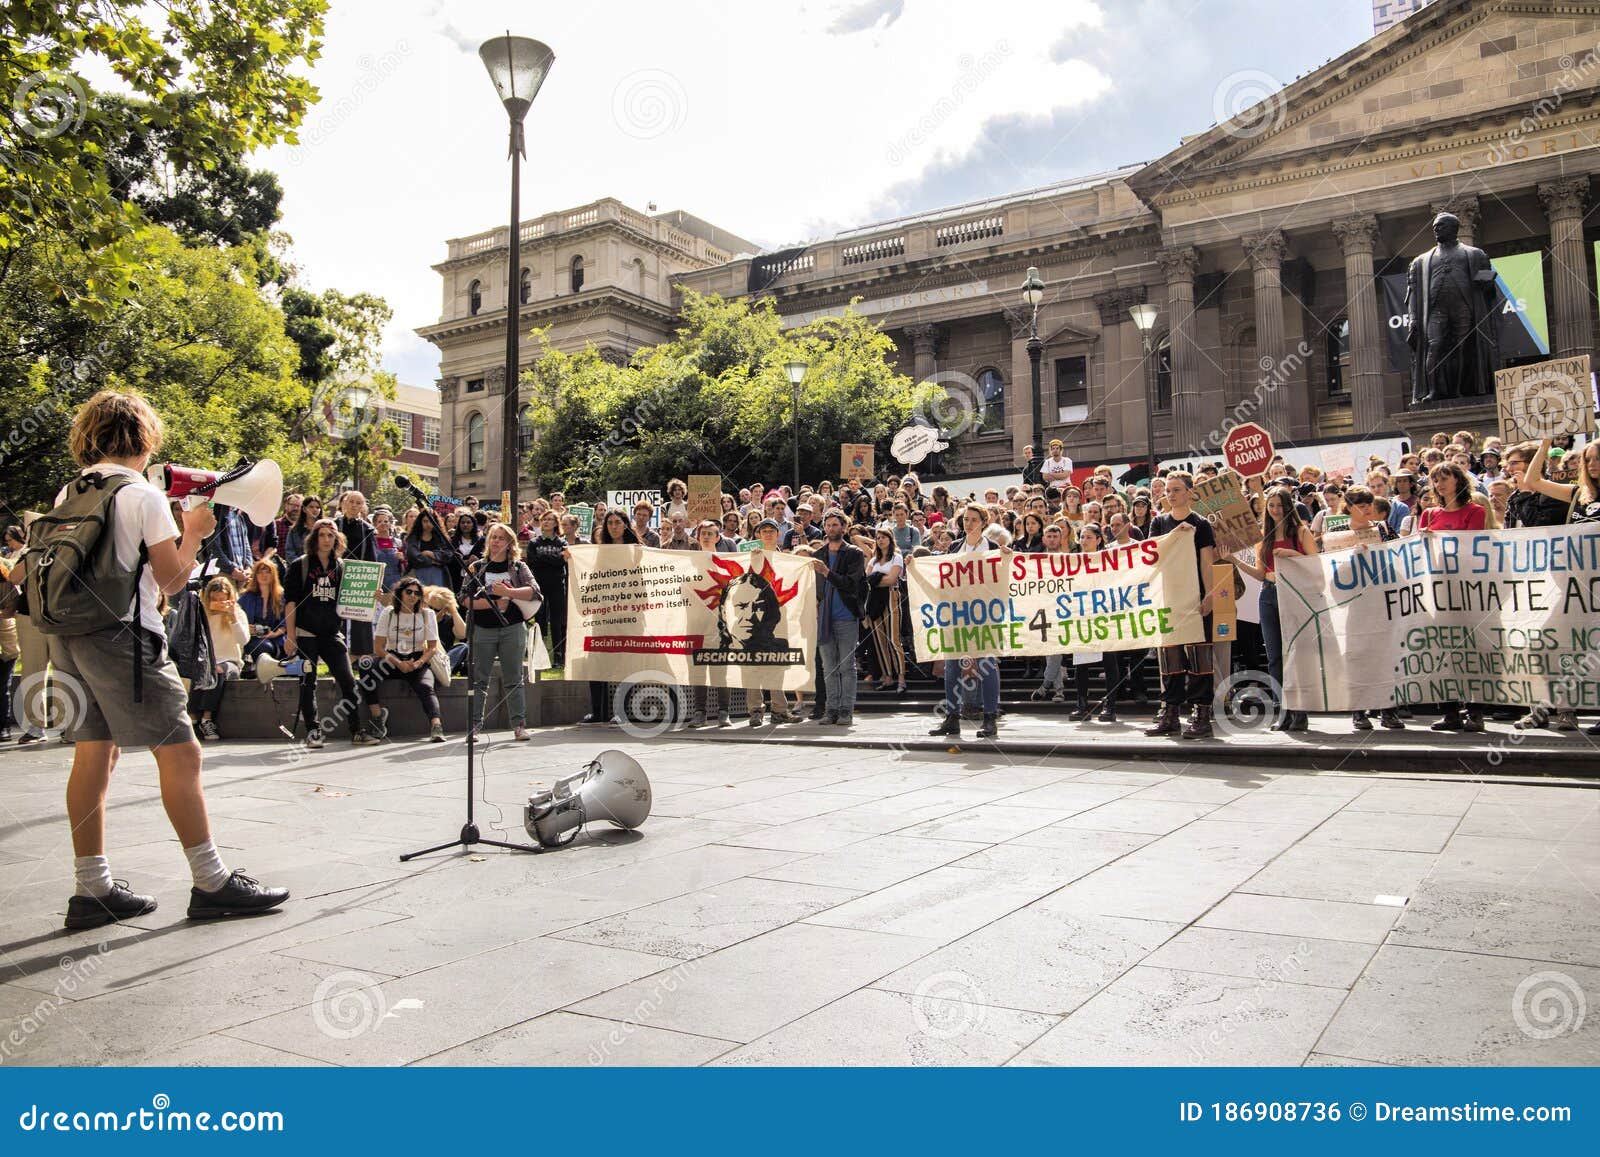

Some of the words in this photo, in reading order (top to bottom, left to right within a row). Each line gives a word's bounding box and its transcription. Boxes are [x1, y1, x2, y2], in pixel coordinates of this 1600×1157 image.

[1410, 131, 1600, 178] VICTORI
[1496, 372, 1516, 388] MY
[1521, 360, 1584, 383] EDUCATION
[1500, 396, 1548, 418] NEED
[1504, 405, 1593, 443] PROTEST
[1229, 433, 1262, 452] #STOP
[1235, 447, 1267, 466] ADANI
[615, 491, 661, 507] CHOOSE
[346, 565, 378, 574] SYSTEM
[589, 568, 628, 580] solutions
[629, 566, 658, 575] within
[660, 564, 675, 573] the
[939, 556, 1001, 589] RMIT
[1012, 540, 1159, 581] STUDENTS
[1330, 536, 1459, 590] UNIMELB
[344, 573, 378, 581] CHANGE
[612, 581, 626, 589] are
[628, 580, 639, 588] so
[641, 575, 691, 588] impossible
[693, 574, 703, 582] to
[340, 589, 375, 597] CLIMATE
[602, 592, 632, 603] maybe
[634, 591, 648, 599] we
[650, 587, 681, 597] should
[1009, 578, 1075, 597] SUPPORT
[340, 596, 374, 605] CHANGE
[920, 597, 1026, 628] SCHOOL
[1056, 582, 1152, 620] STRIKE
[1384, 583, 1427, 620] FOR
[1433, 579, 1549, 612] CLIMATE
[582, 606, 611, 617] change
[612, 604, 628, 613] the
[631, 602, 664, 613] system
[926, 622, 1024, 654] CLIMATE
[1057, 607, 1175, 647] JUSTICE
[1028, 608, 1052, 643] 4
[590, 639, 622, 648] Socialist
[625, 640, 670, 649] Alternative
[672, 641, 694, 649] RMIT
[1490, 628, 1559, 651] JOBS
[697, 652, 752, 663] #SCHOOL
[754, 652, 801, 662] STRIKE!
[1469, 680, 1540, 704] FOSSIL
